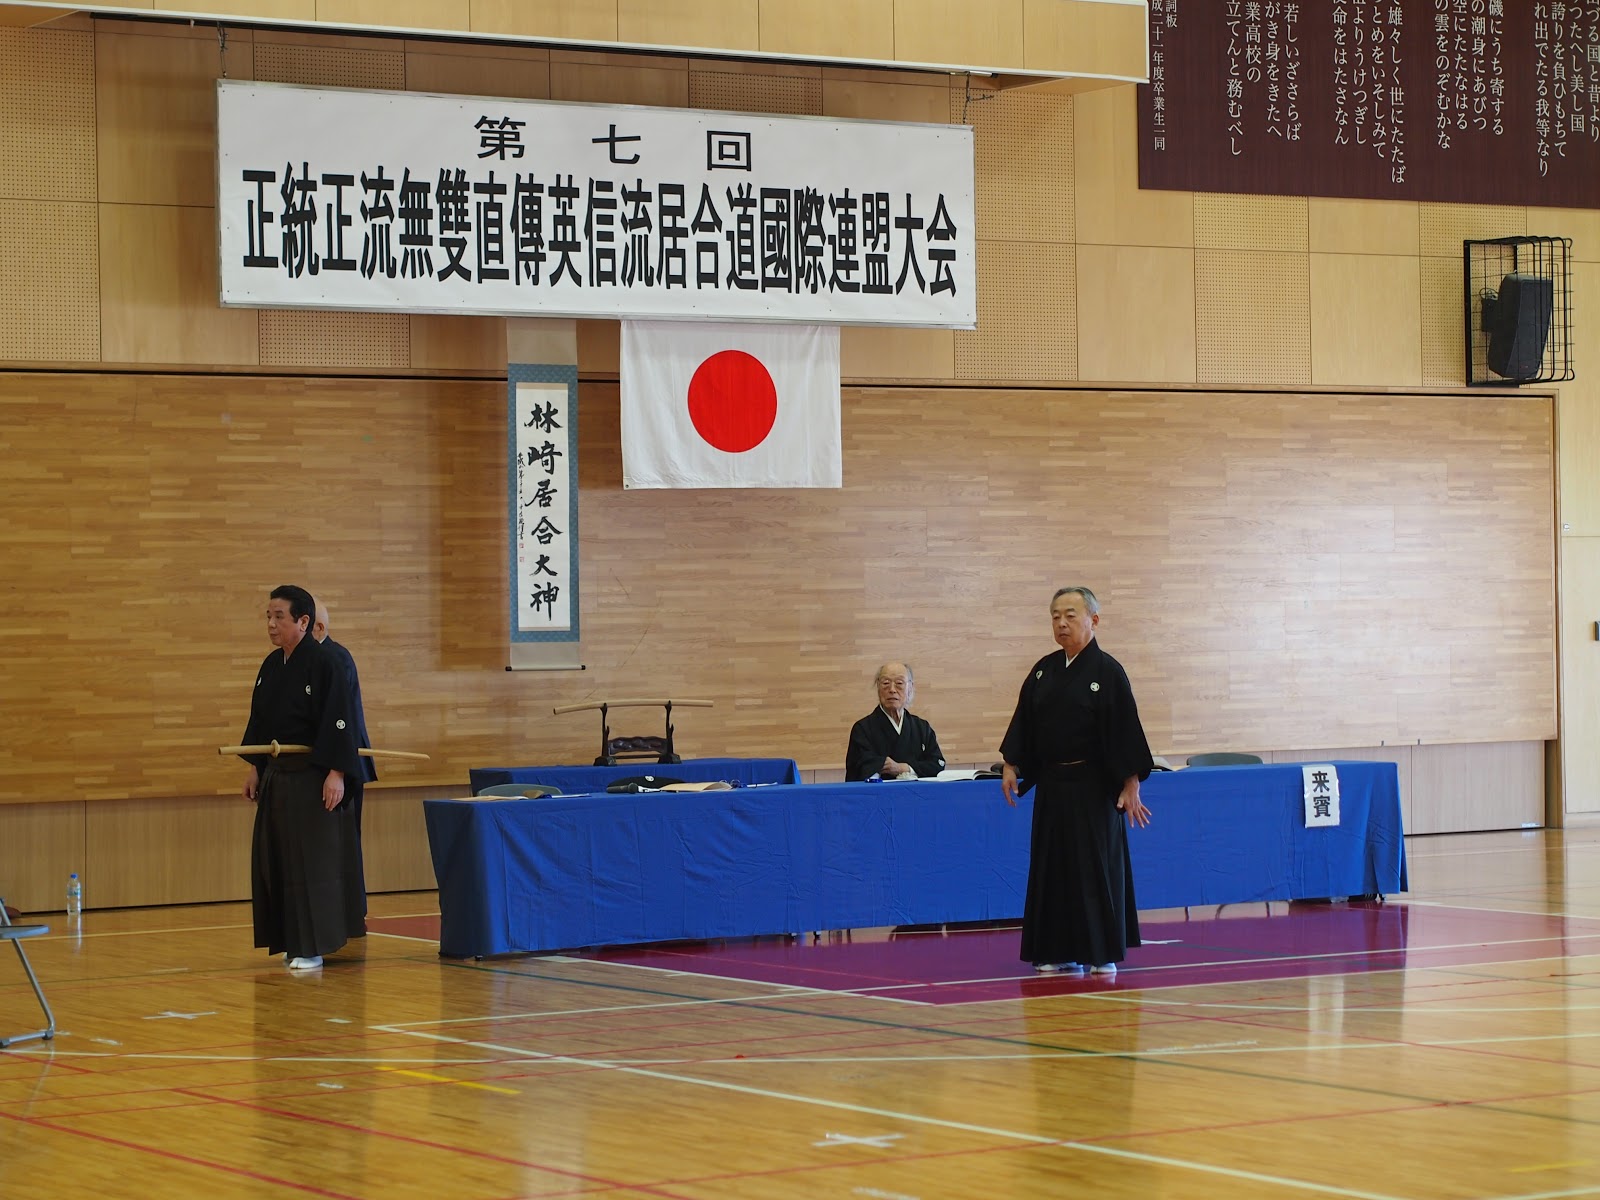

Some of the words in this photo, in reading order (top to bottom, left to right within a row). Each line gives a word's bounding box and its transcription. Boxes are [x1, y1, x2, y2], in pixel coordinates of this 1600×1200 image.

[1166, 0, 1178, 28] 詞板
[1245, 2, 1262, 83] 業高校の
[1265, 1, 1282, 137] がき身をきたへ
[1332, 0, 1349, 145] 命をはたさなん
[1353, 0, 1368, 145] よりうけつぎし
[1371, 0, 1387, 158] とめをいそしみて
[1435, 0, 1451, 149] の雲をのぞむかな
[1472, 0, 1487, 130] の潮身にあびつ
[1551, 2, 1567, 157] 誇りを負ひもちて
[1570, 0, 1585, 133] つたへし美し国
[1586, 0, 1600, 143] づる国と昔より
[1534, 2, 1550, 177] れ出でたる我等なり
